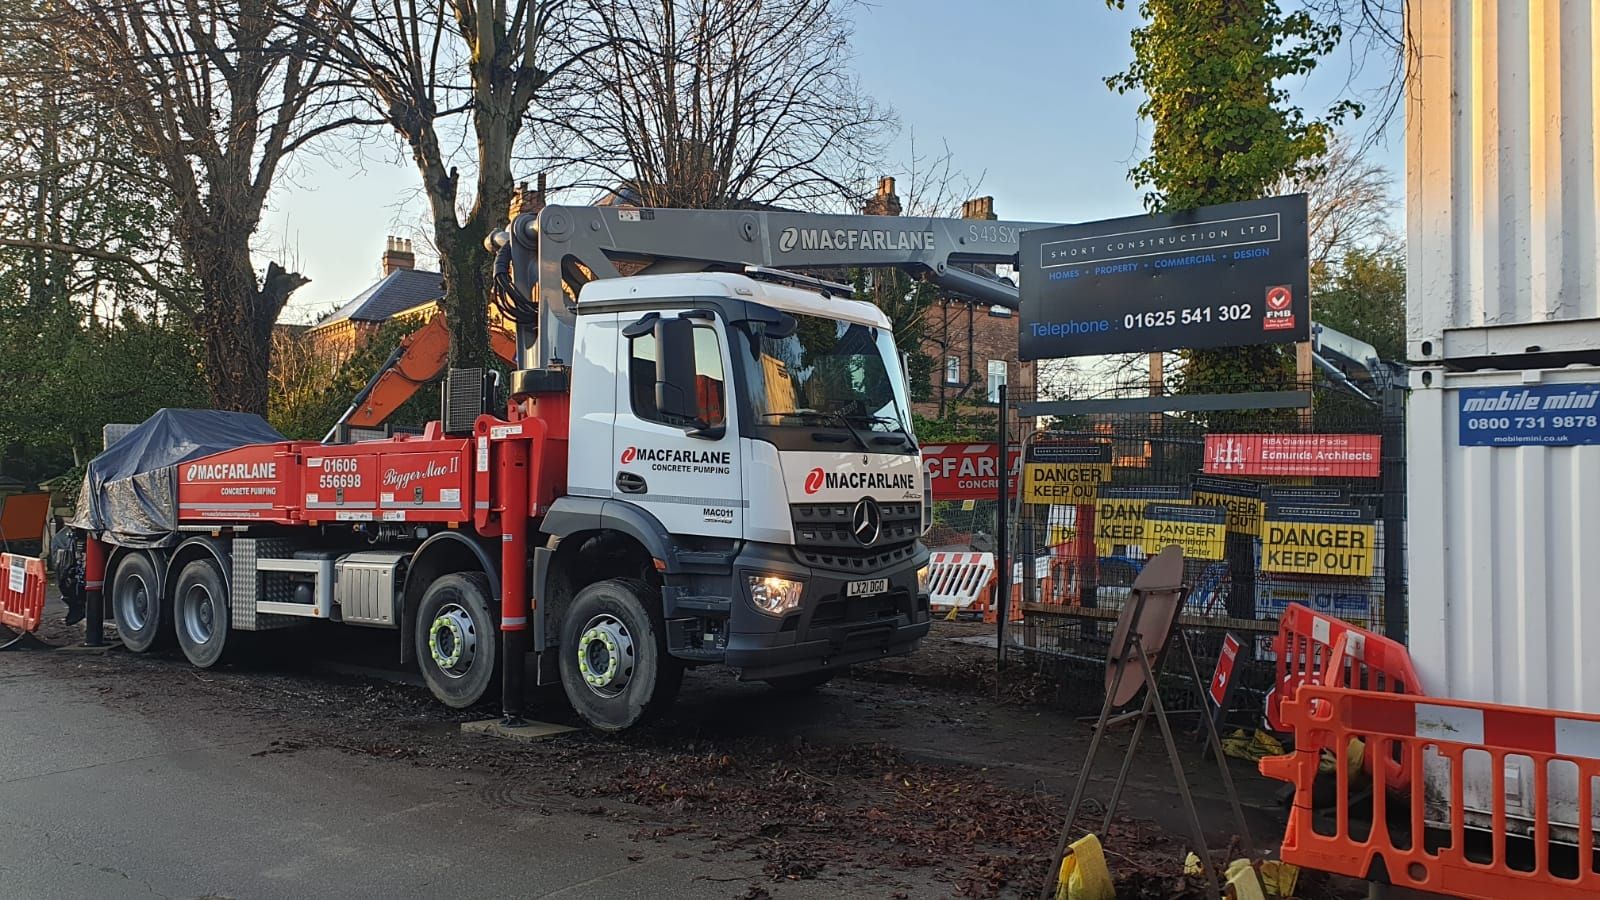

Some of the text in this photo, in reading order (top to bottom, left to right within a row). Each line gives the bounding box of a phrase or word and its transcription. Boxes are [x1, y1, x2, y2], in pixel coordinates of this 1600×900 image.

[801, 229, 935, 250] MACFARLANE
[1051, 225, 1267, 258] SHORT CONSTRUCTION LTD
[1048, 248, 1270, 280] HOMES PROPERTY COMMERCIAL DESIGN
[1030, 318, 1110, 338] Telephone
[1123, 310, 1176, 329] 01625
[1181, 307, 1212, 325] 541
[1218, 303, 1252, 322] 302
[1266, 310, 1291, 318] FMB
[1462, 390, 1600, 412] mobile mini
[1468, 415, 1597, 430] 0800 731 9878
[1262, 438, 1281, 446] RIBA
[1494, 434, 1569, 443] mobilemini.co.uk
[636, 448, 731, 464] MACFARLANE
[1262, 449, 1373, 461] Edmunds Architects
[197, 462, 276, 480] MACFARLANE
[323, 458, 357, 473] 01606
[651, 464, 730, 475] CONCRETE PUMPING
[319, 473, 361, 489] 556698
[383, 468, 422, 490] Bigger
[422, 459, 448, 479] Mac
[825, 472, 914, 490] MACFARLANE
[1034, 468, 1102, 482] DANGER
[220, 487, 276, 496] CONCRETE PUMPING
[1034, 485, 1070, 497] KEEP
[703, 507, 734, 518] MAC011
[1230, 515, 1257, 528] OUT
[1101, 524, 1144, 539] KEEP
[1154, 523, 1216, 537] DANGER
[1160, 535, 1207, 546] Demolition
[1269, 527, 1366, 549] DANGER
[1187, 546, 1211, 556] Enter
[1268, 550, 1366, 571] KEEP OUT
[851, 581, 868, 595] LX21
